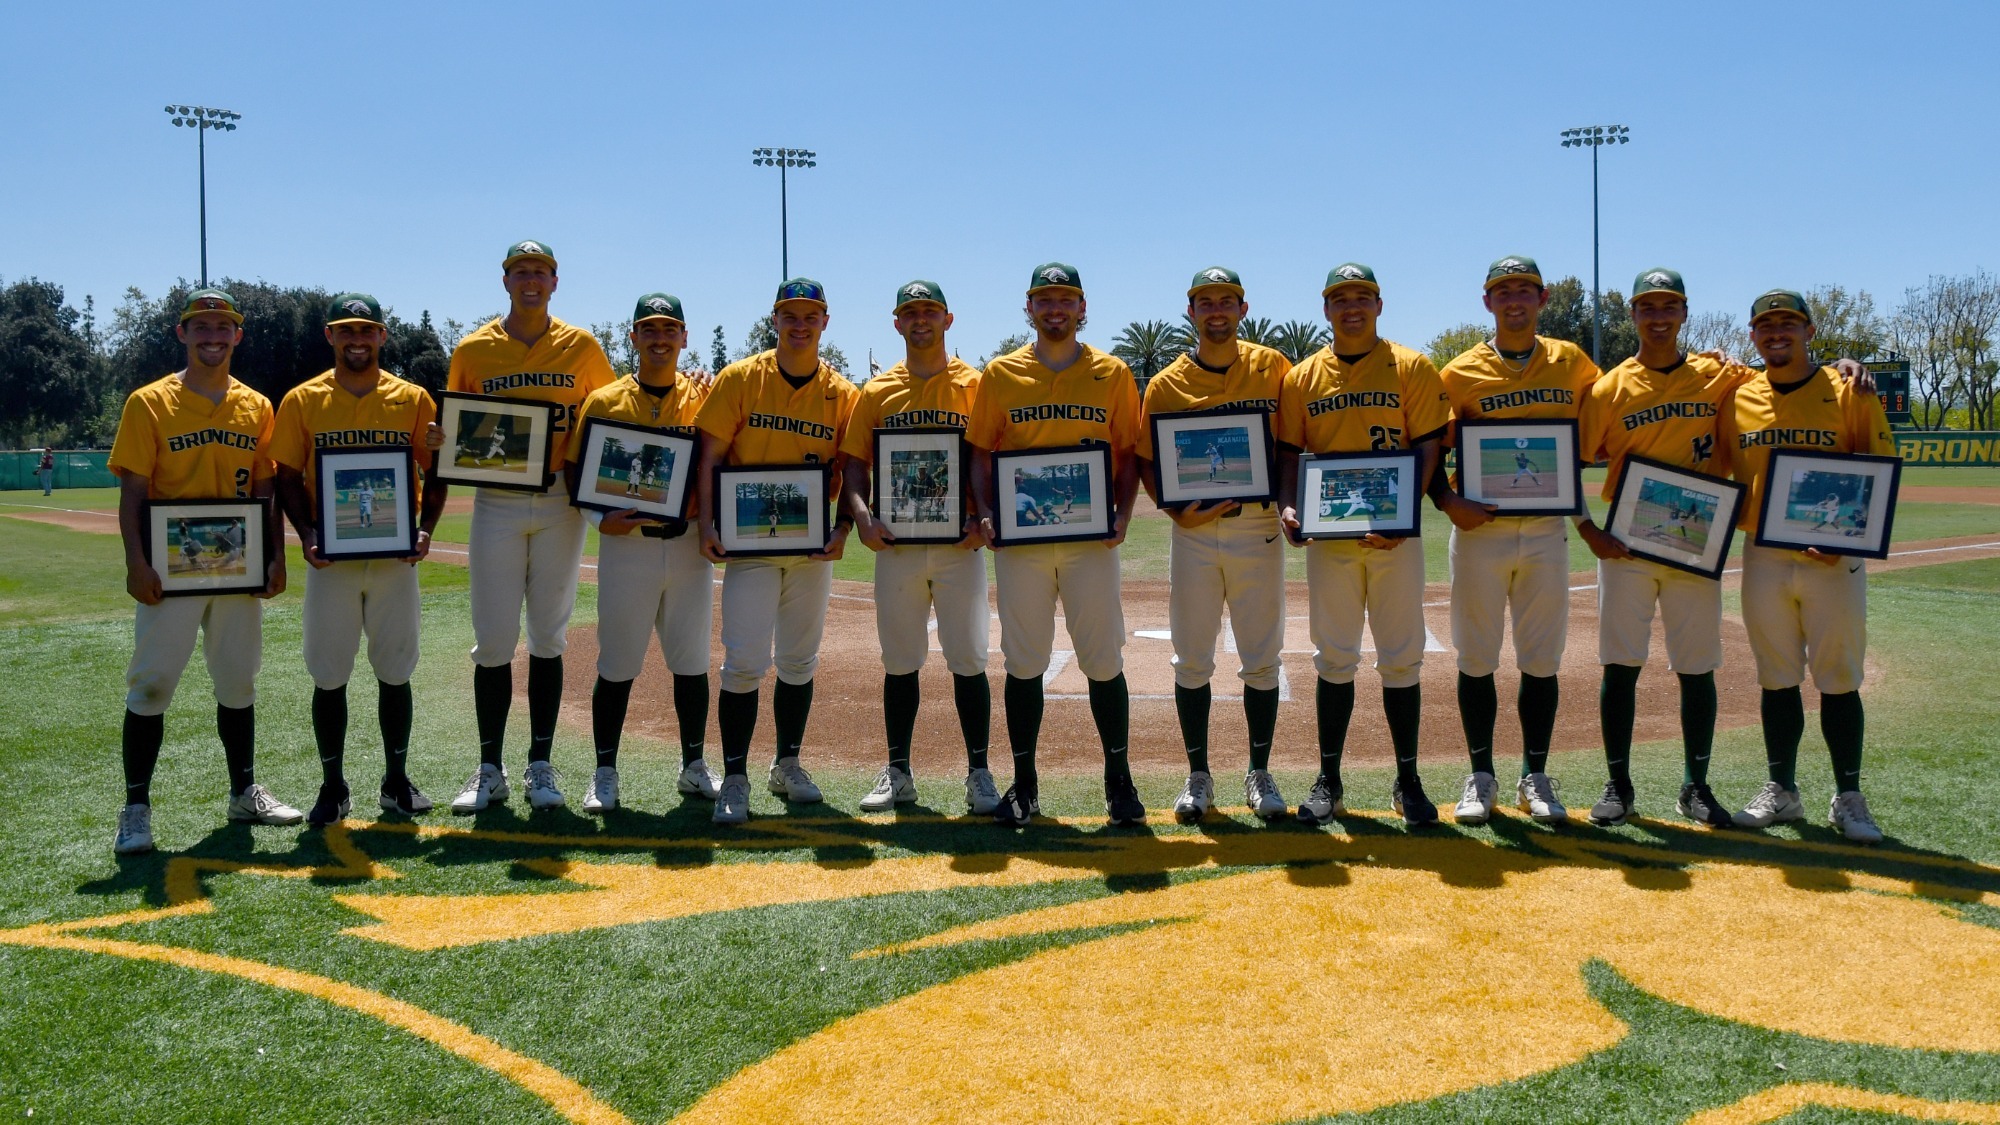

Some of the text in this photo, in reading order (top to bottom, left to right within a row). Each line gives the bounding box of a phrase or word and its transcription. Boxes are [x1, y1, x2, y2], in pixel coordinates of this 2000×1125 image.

[482, 373, 576, 395] BRONCOS
[1306, 392, 1400, 417] BRONCOS
[1479, 388, 1574, 413] BRONCOS
[748, 411, 835, 441] BRONCOS
[883, 409, 970, 428] BRONCOS
[1009, 404, 1107, 424] BRONCOS
[1622, 402, 1718, 431] BRONCOS
[167, 428, 258, 452] BRONCOS
[314, 429, 412, 448] BRONCOS
[1369, 425, 1402, 451] 25
[1691, 433, 1714, 464] 12
[1738, 428, 1837, 450] BRONCOS
